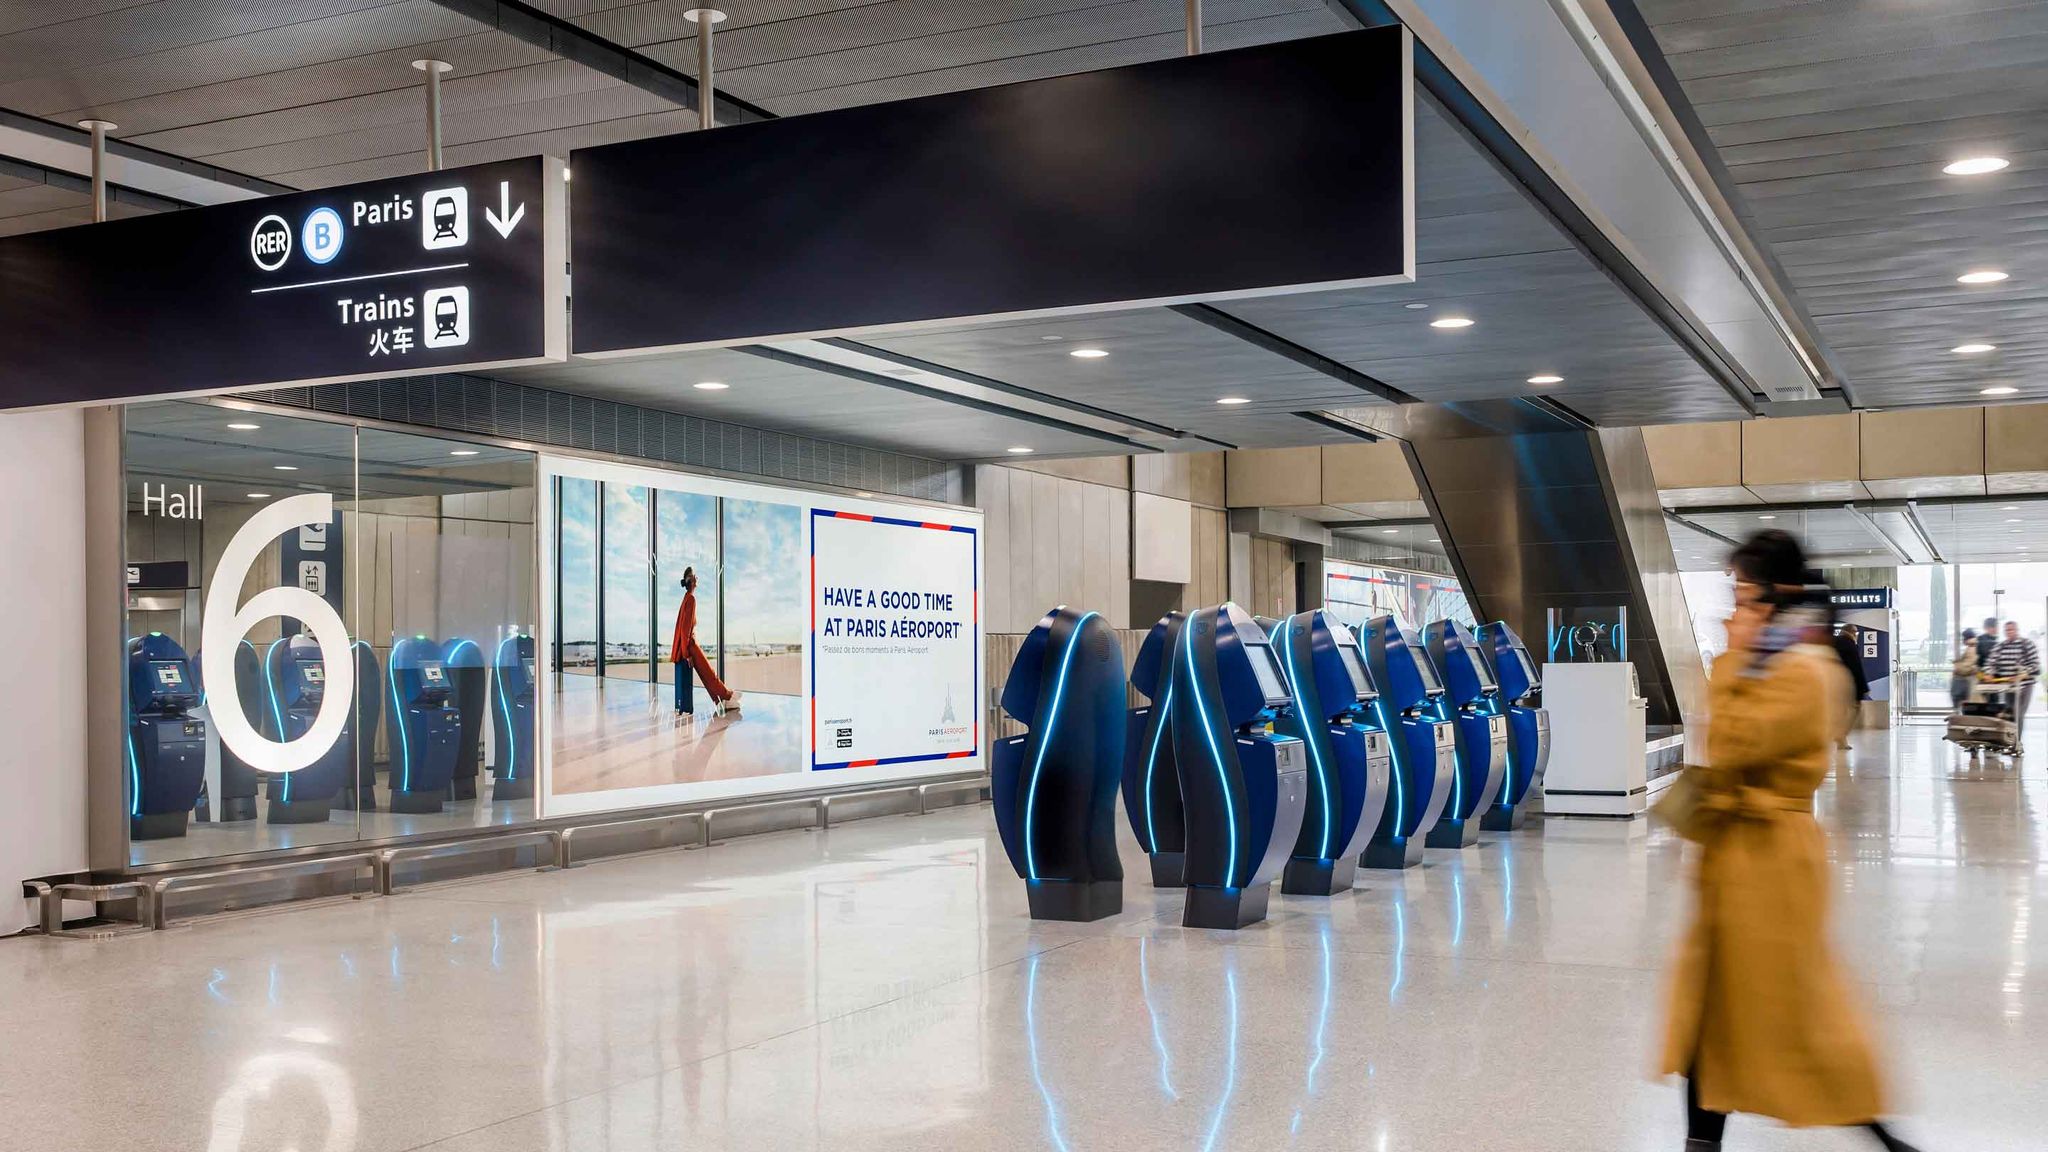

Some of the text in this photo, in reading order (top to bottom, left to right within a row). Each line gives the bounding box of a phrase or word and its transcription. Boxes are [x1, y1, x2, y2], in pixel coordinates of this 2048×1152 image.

[256, 195, 413, 254] RER B Paris
[337, 293, 415, 325] Trains
[369, 326, 414, 356] 火车
[142, 481, 204, 520] Hall
[824, 587, 953, 611] HAVE A GOOD TIME
[1840, 595, 1881, 603] BILLETS
[202, 493, 354, 773] 6
[824, 617, 842, 637] AT
[847, 619, 886, 638] PARIS
